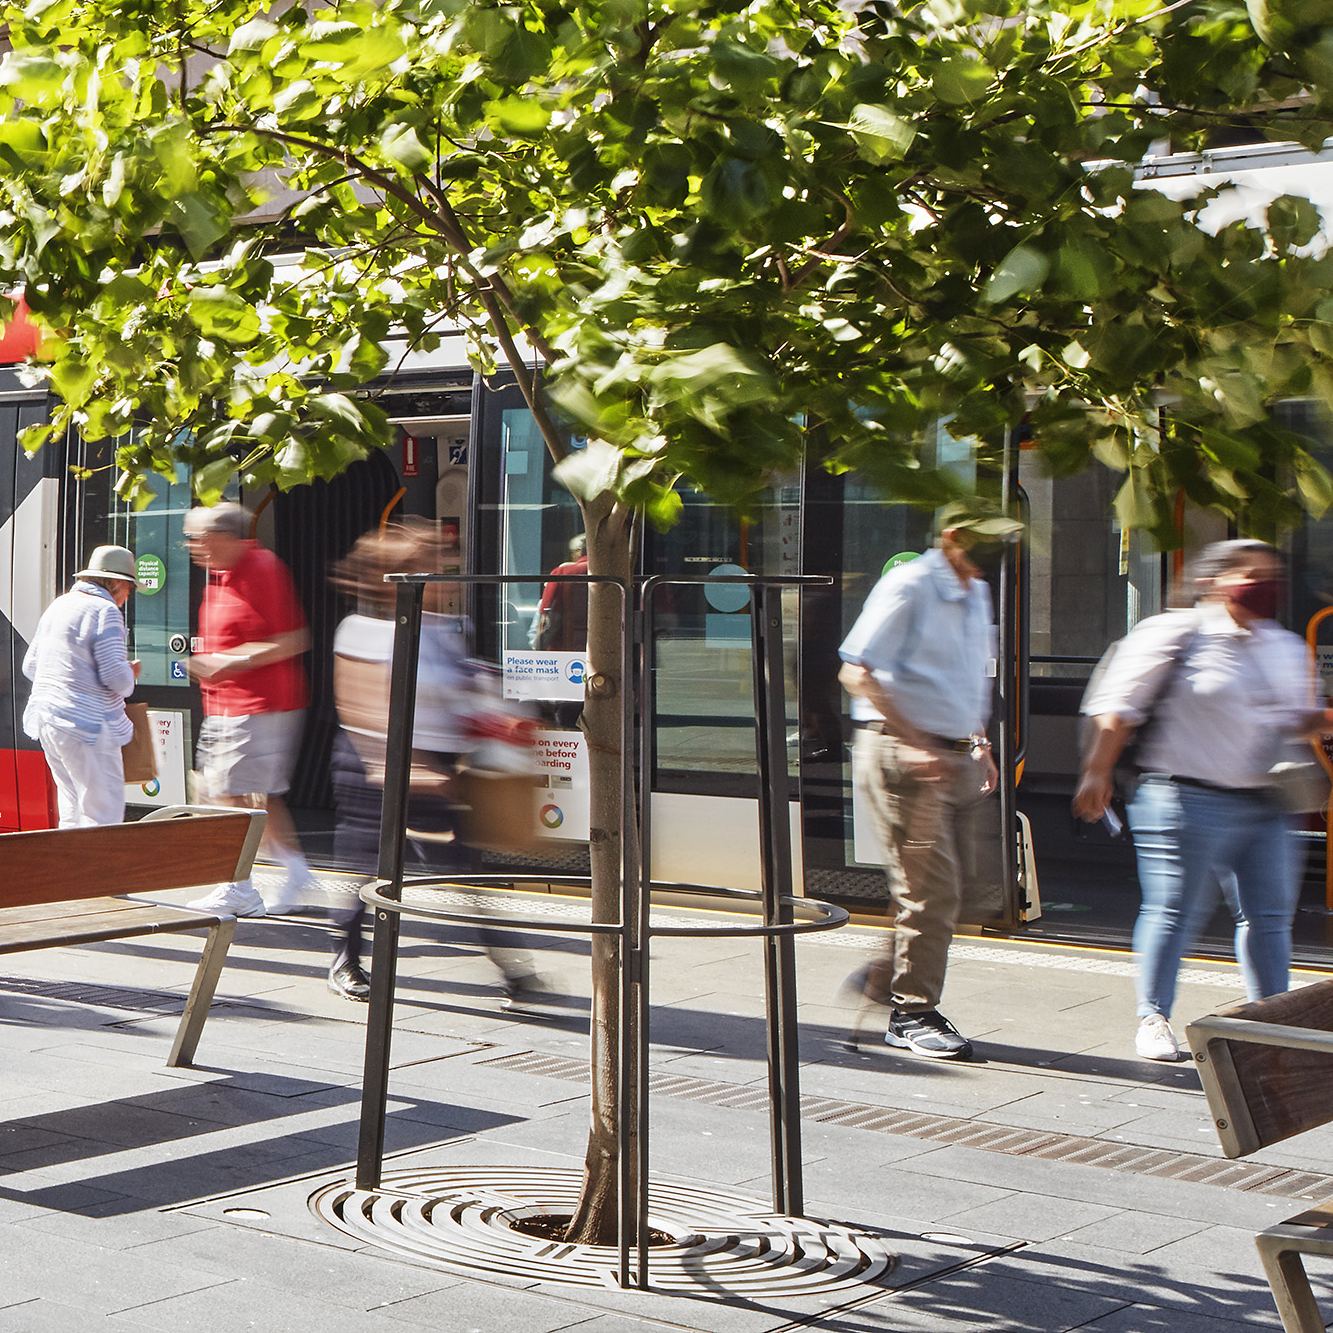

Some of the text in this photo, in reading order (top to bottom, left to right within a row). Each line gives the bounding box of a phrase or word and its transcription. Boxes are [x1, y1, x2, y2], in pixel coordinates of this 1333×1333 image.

[507, 657, 534, 665] Please
[535, 666, 559, 674] mask
[538, 739, 550, 747] on
[552, 741, 579, 750] every
[546, 748, 577, 758] before
[534, 759, 571, 770] oarding
